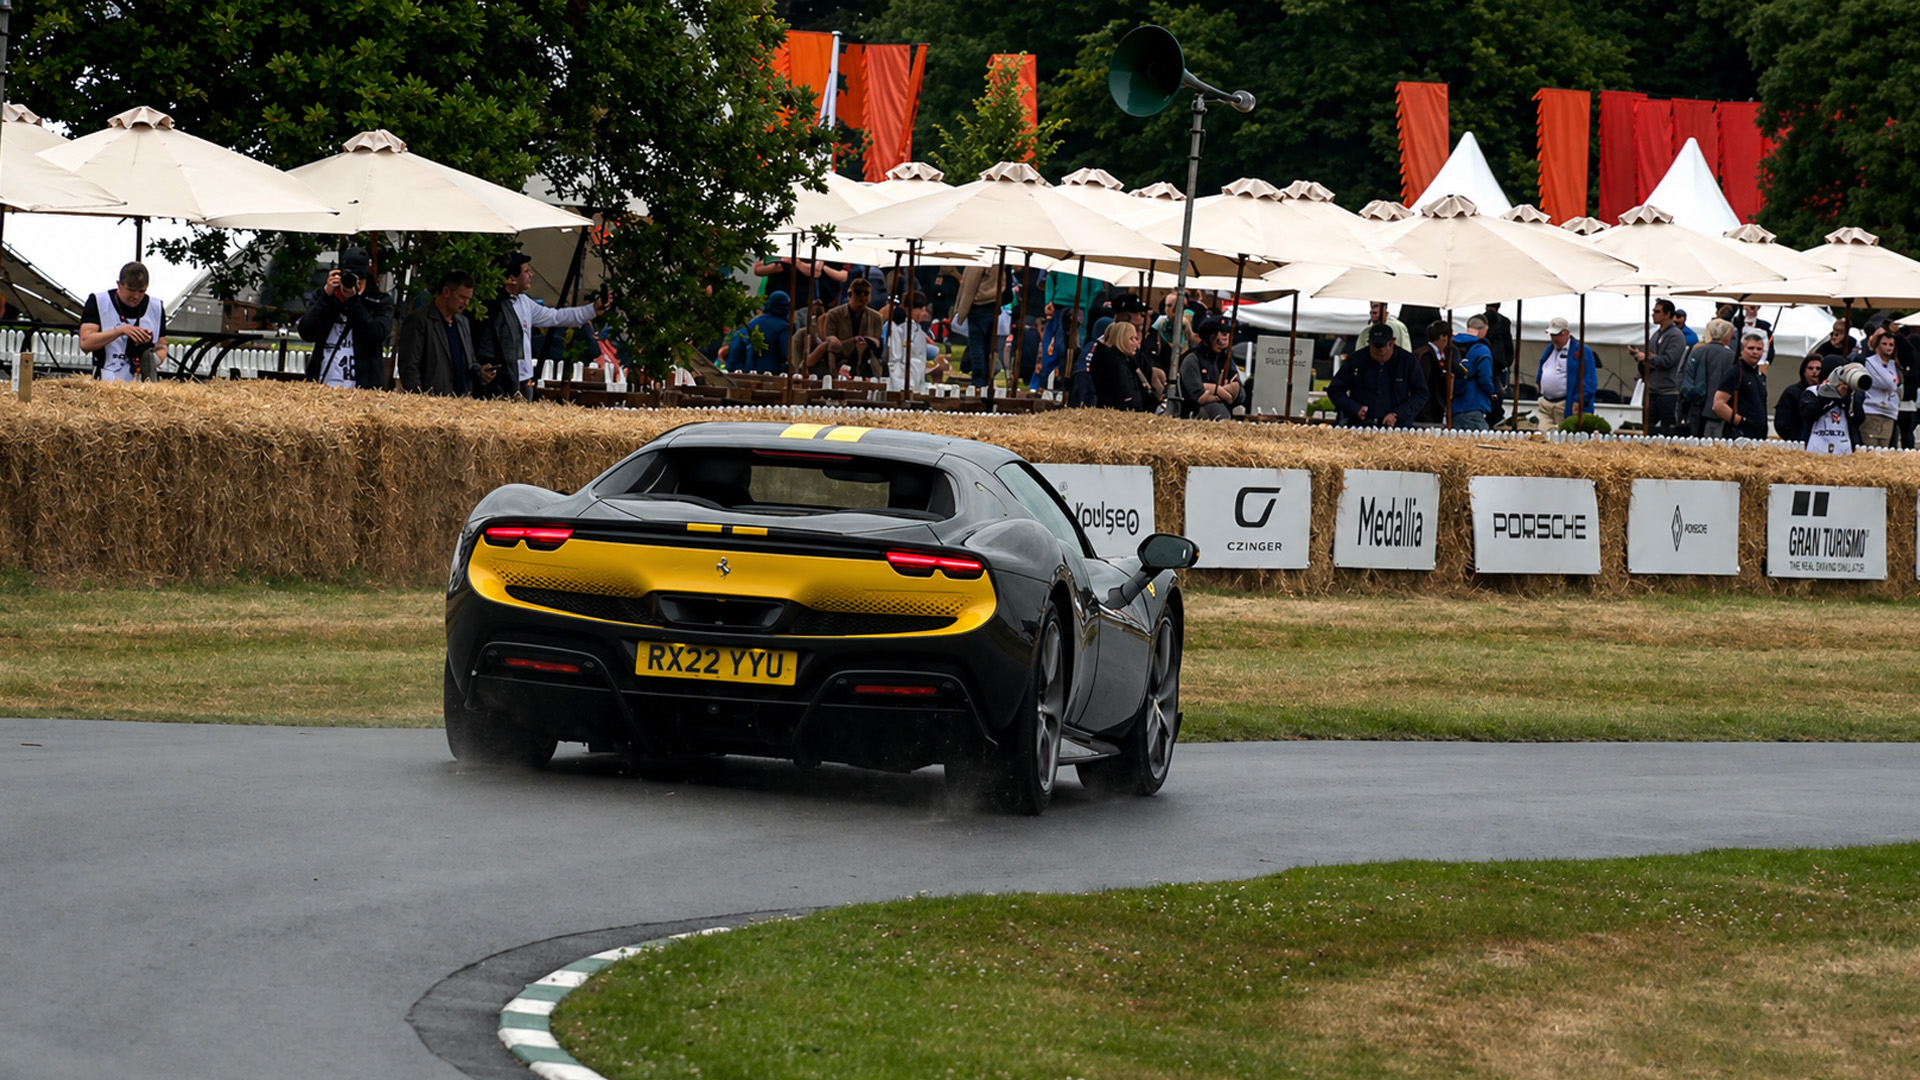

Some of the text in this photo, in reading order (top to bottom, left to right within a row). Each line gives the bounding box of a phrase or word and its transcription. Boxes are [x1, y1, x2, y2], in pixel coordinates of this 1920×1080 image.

[1357, 496, 1424, 547] Medallia
[1493, 513, 1586, 539] PORSCHE
[1227, 541, 1282, 551] CZINGER
[1789, 526, 1866, 558] GRAN TURISMO
[648, 644, 784, 679] RX22 YYU
